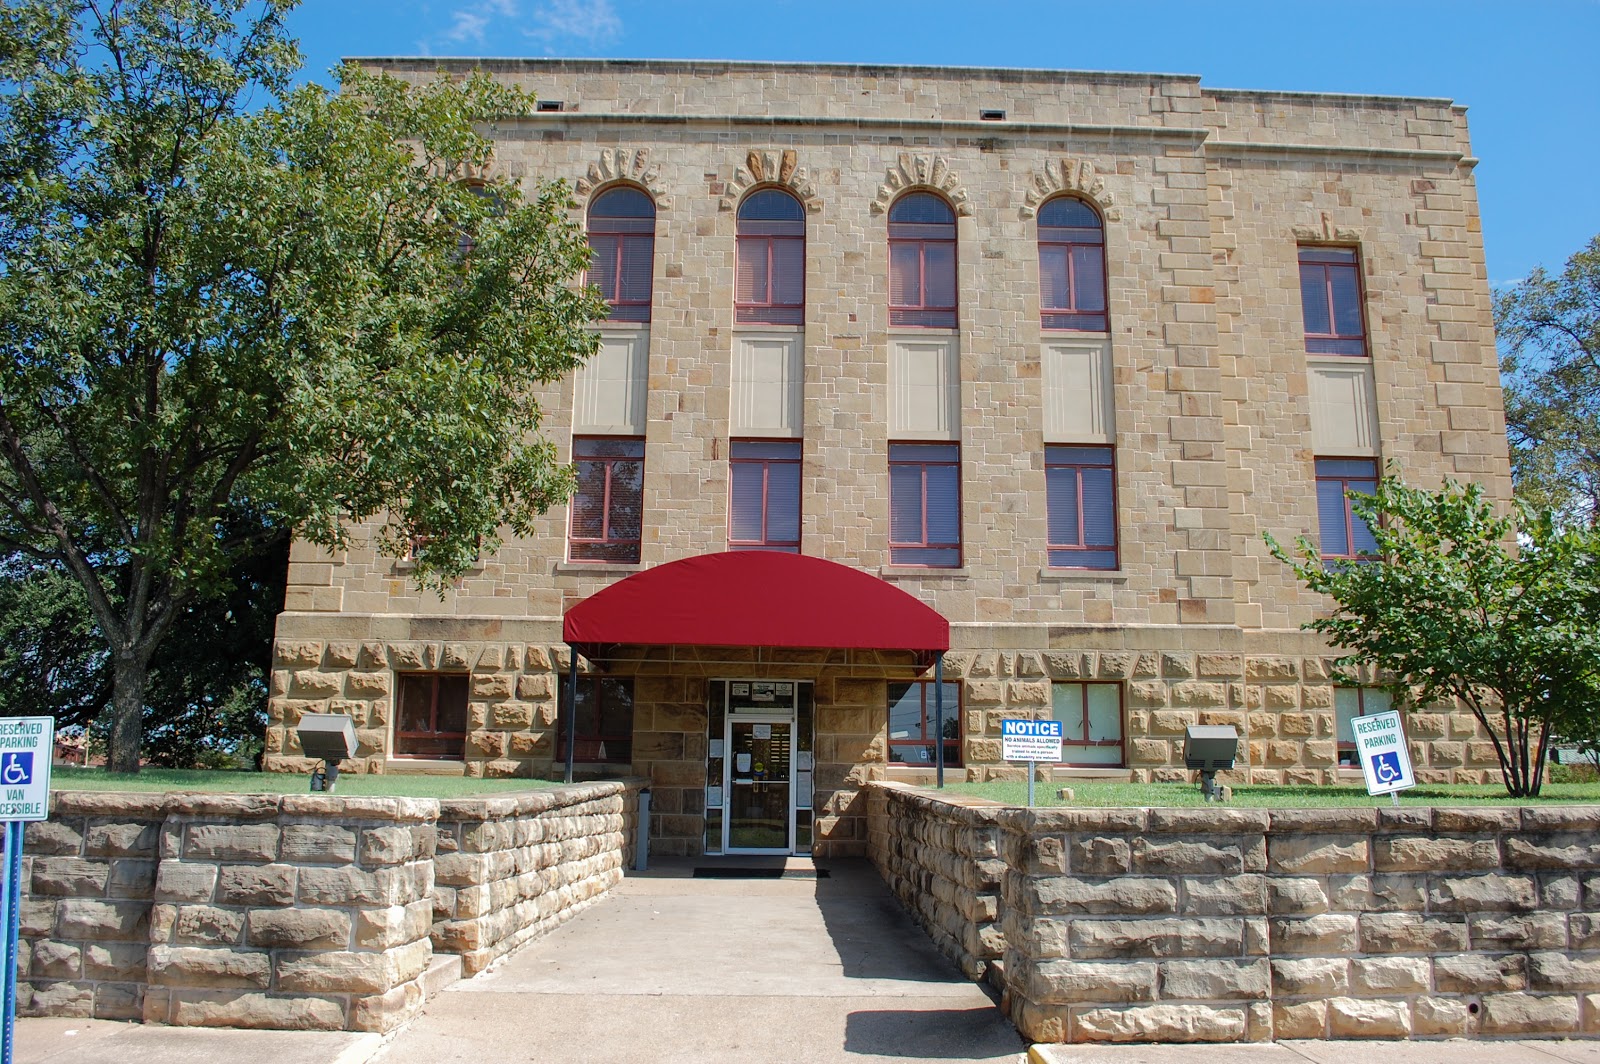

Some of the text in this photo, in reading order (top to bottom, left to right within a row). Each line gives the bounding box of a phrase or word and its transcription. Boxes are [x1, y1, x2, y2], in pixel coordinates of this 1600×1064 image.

[0, 723, 42, 735] RESERVED
[1005, 721, 1059, 735] NOTICE
[1357, 717, 1396, 734] RESERVED
[0, 736, 38, 748] PARKING
[1364, 733, 1396, 749] PARKING
[6, 789, 25, 801] VAN
